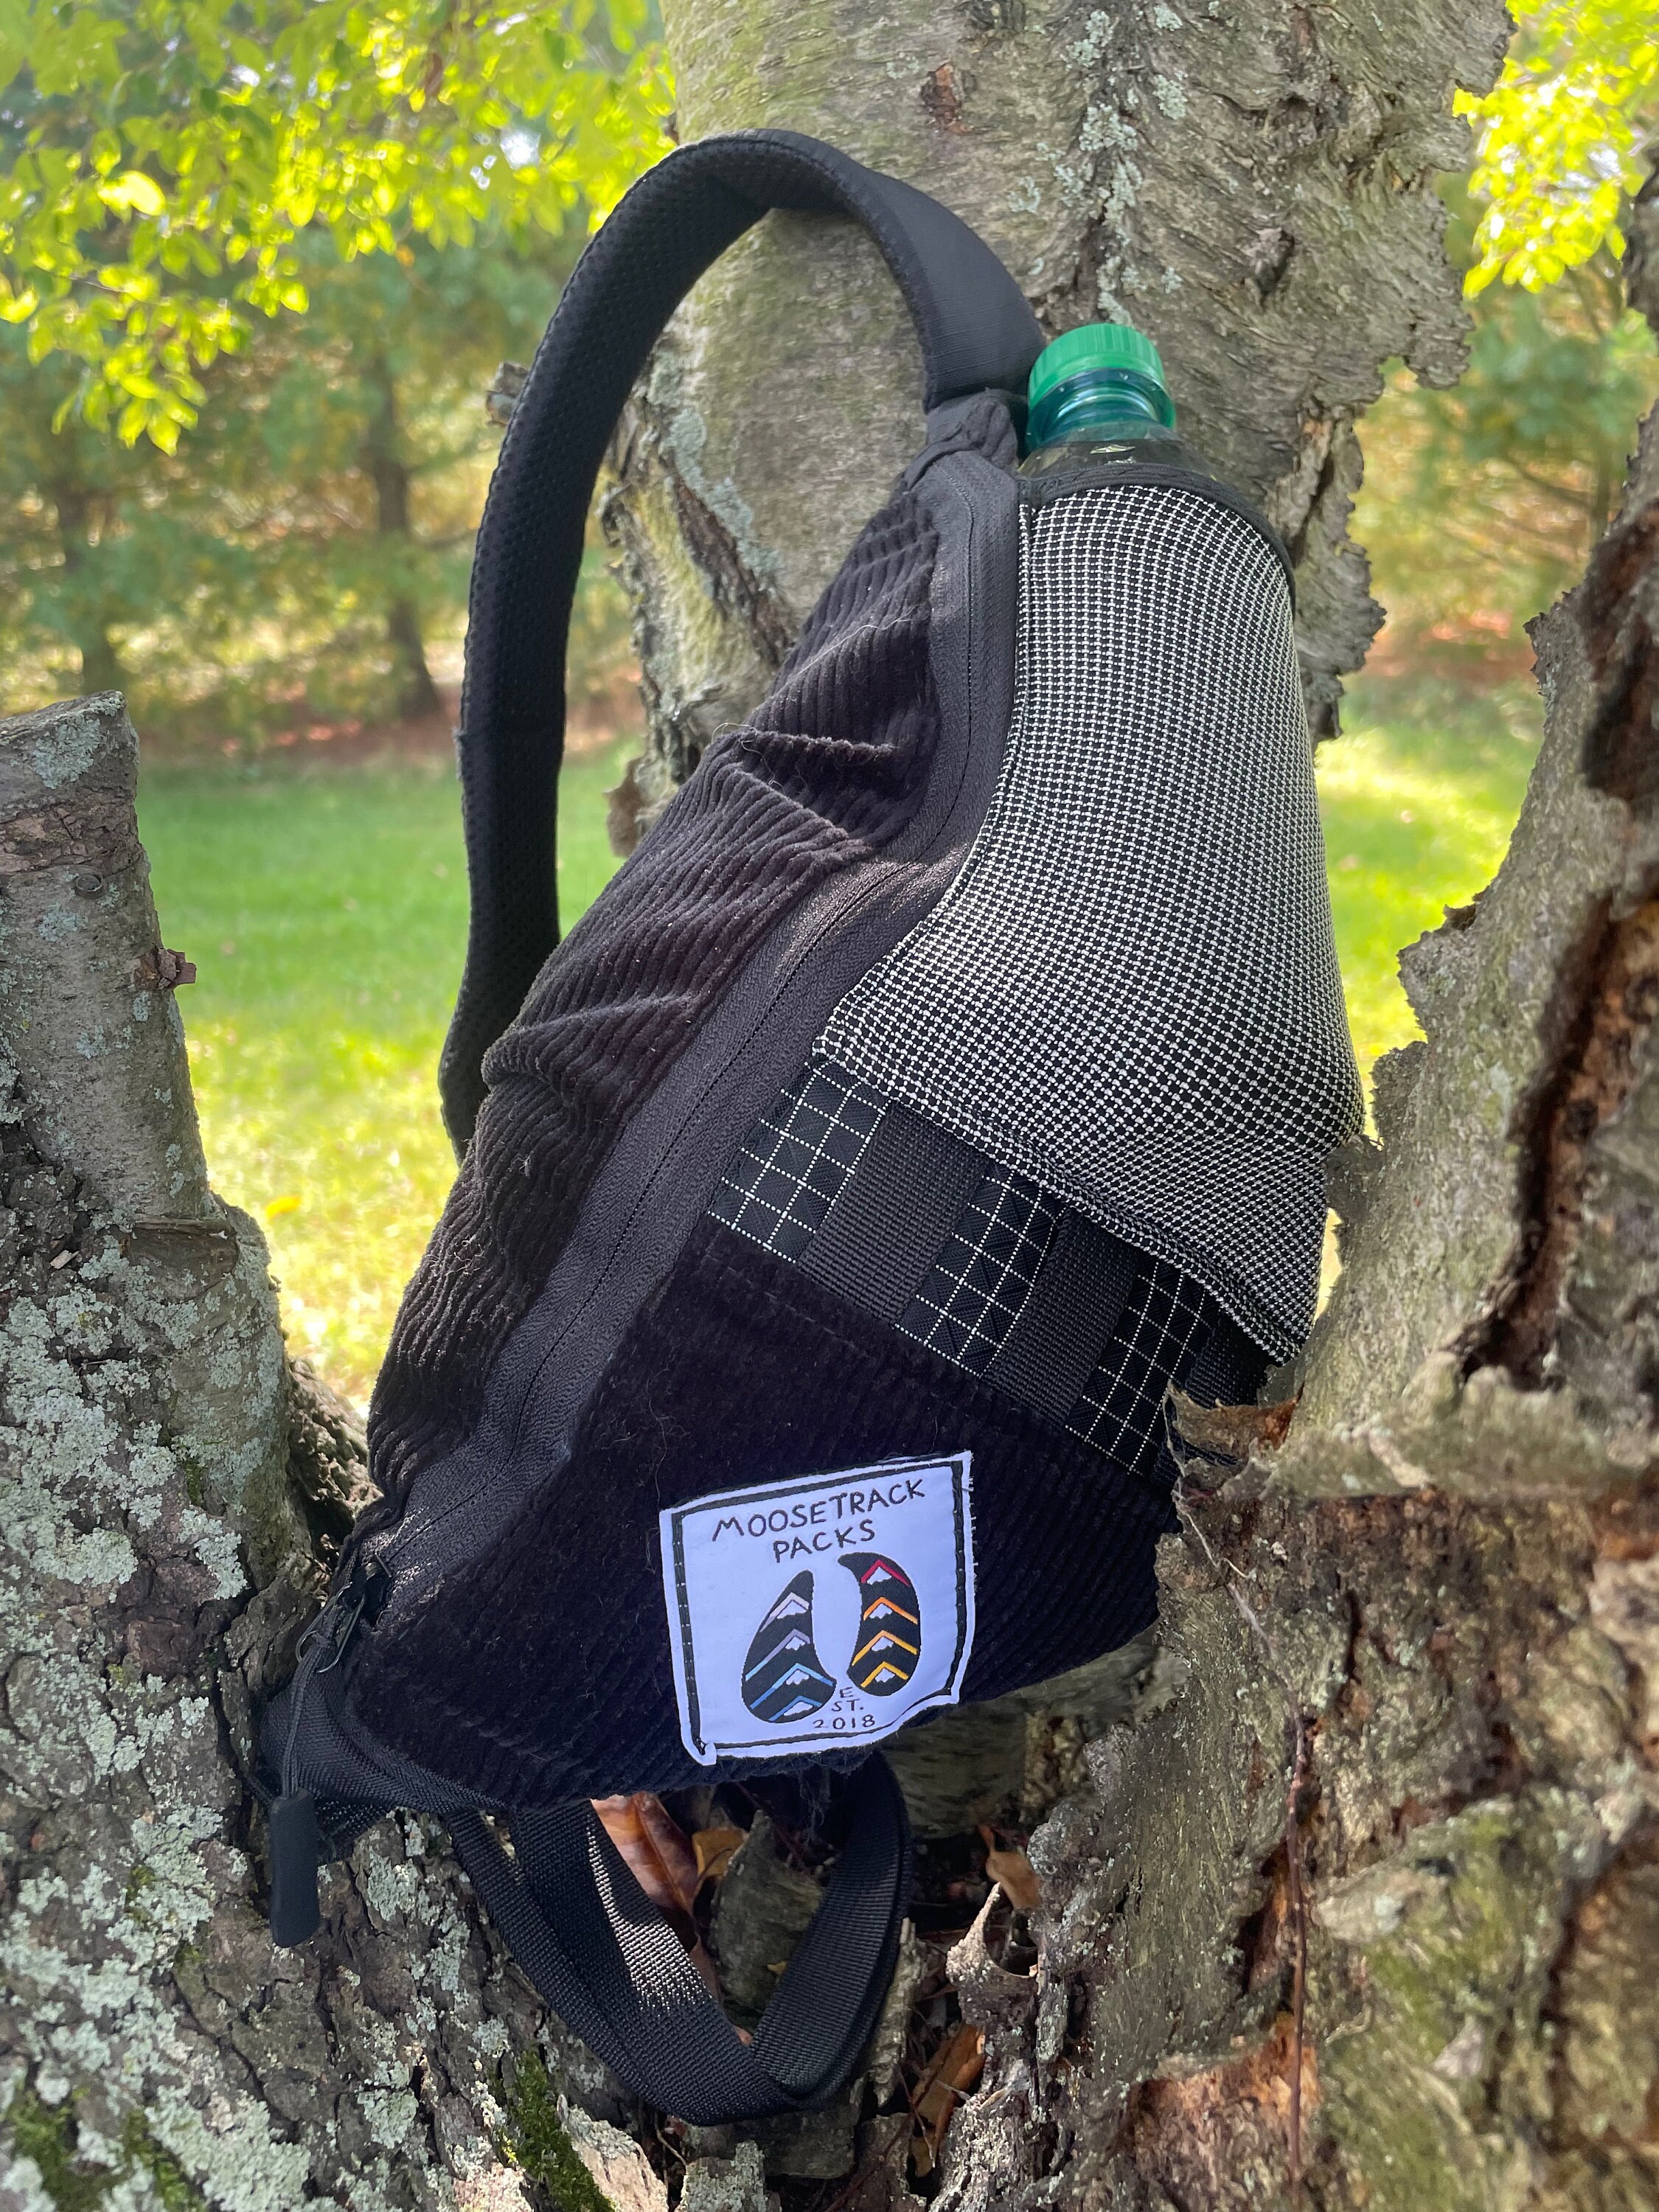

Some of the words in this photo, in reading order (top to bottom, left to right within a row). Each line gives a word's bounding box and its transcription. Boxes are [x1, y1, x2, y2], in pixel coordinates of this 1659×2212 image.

[712, 1478, 925, 1541] MOOSETRACK
[773, 1519, 875, 1562] PACKS
[813, 1714, 875, 1730] 2018
